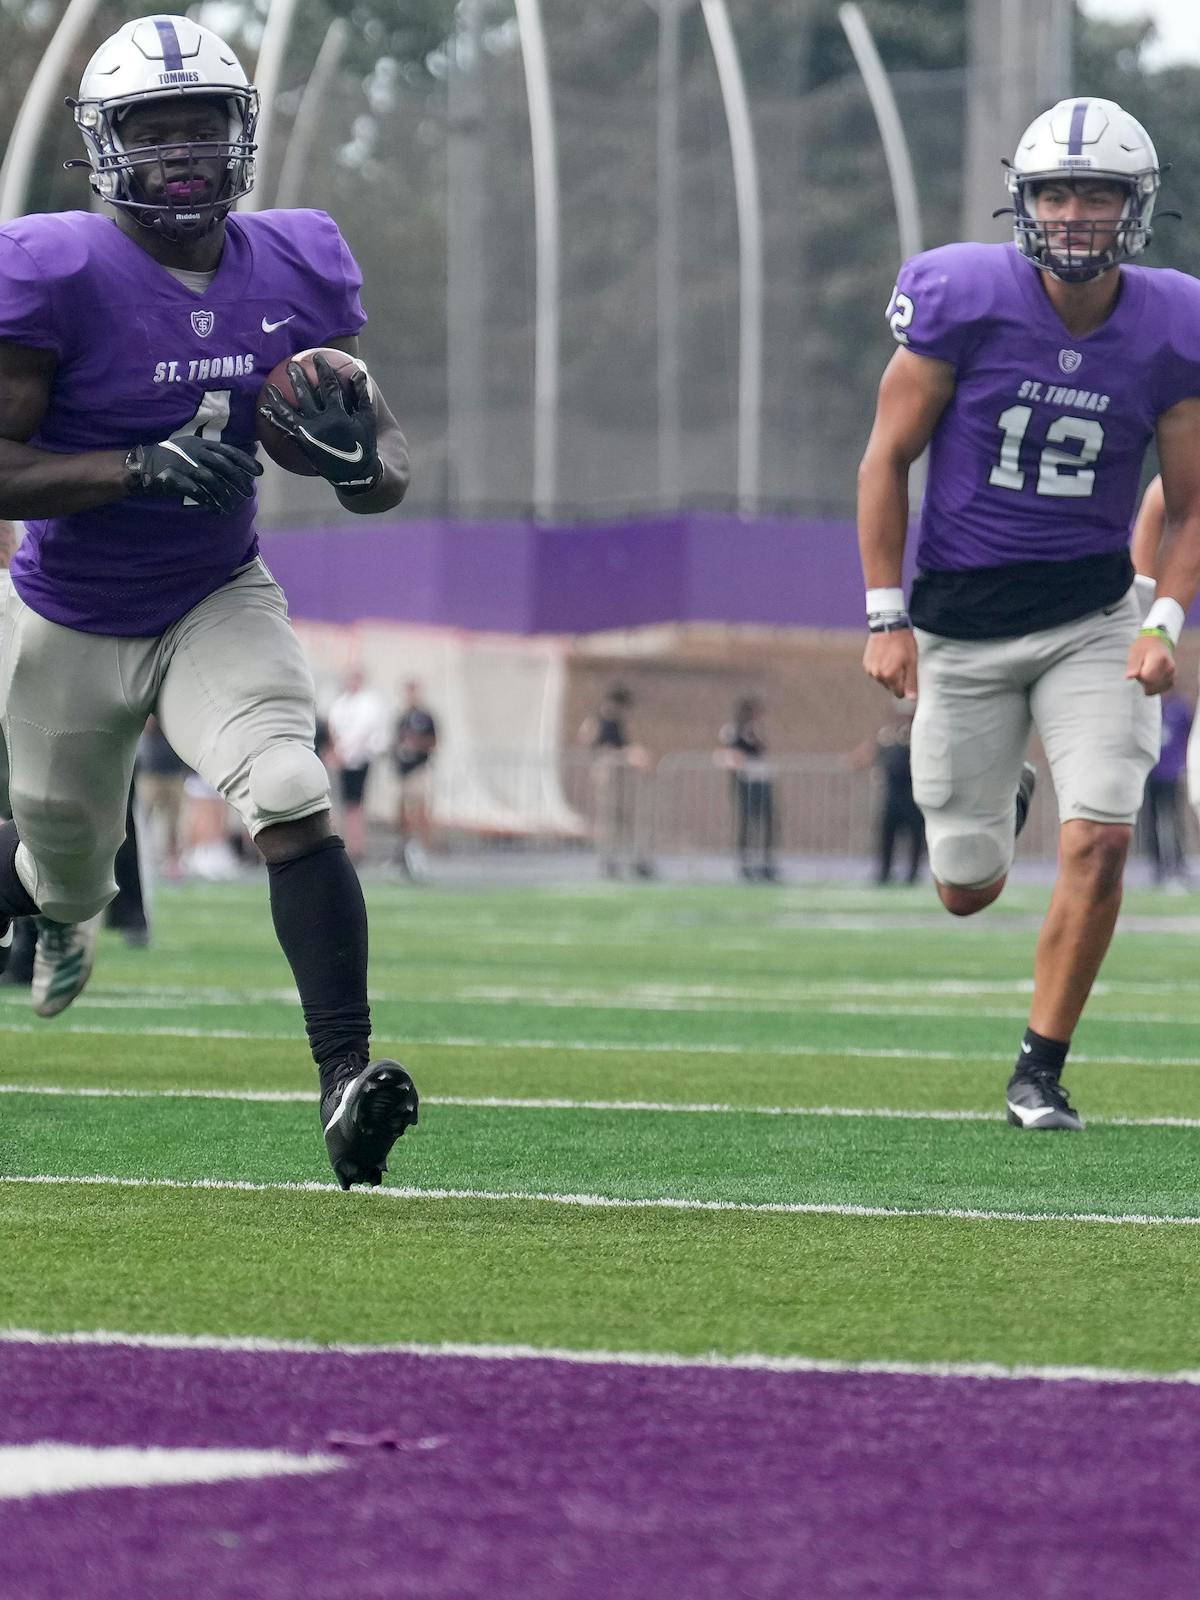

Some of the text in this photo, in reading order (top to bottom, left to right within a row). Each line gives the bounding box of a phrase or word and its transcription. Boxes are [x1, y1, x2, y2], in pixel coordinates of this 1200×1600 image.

[157, 71, 199, 84] TOMMIES
[153, 353, 254, 383] ST. THOMAS
[1017, 380, 1111, 412] ST. THOMAS
[988, 404, 1105, 497] 12
